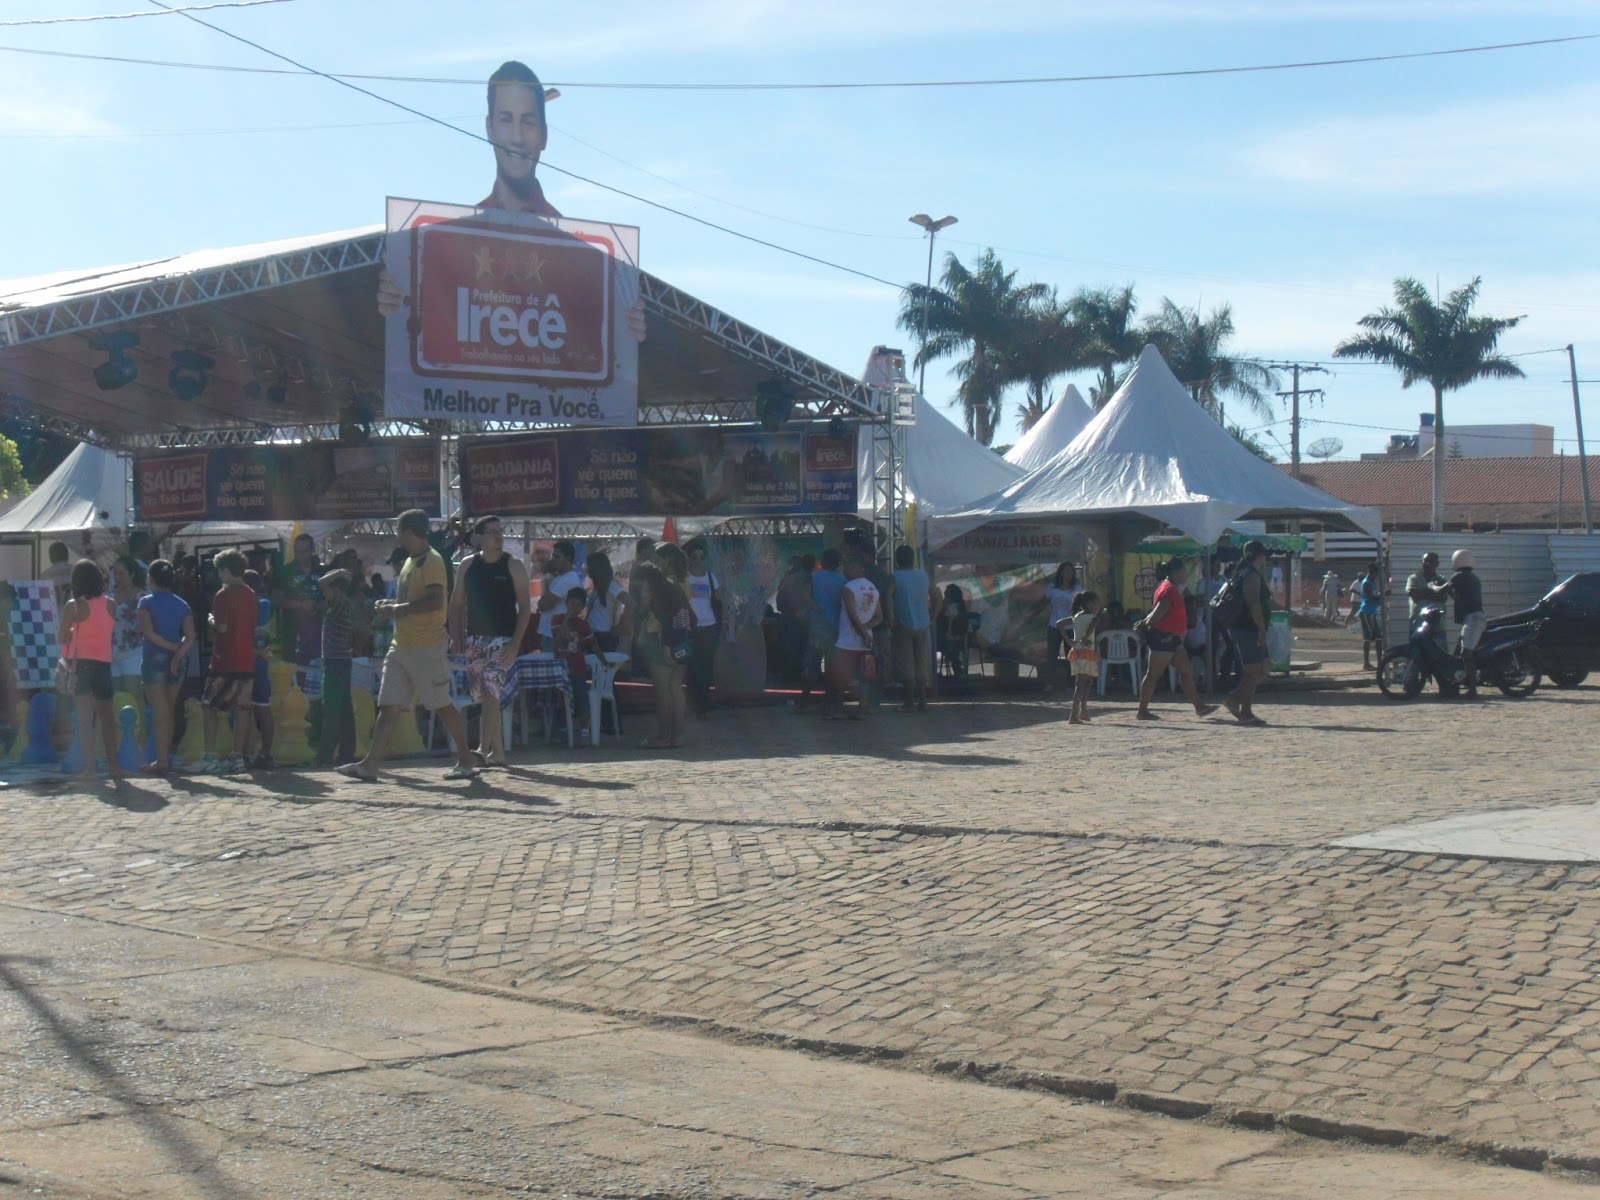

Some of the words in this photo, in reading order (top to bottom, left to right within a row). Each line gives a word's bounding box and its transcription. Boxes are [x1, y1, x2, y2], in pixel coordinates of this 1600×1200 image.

[473, 288, 521, 305] Prefeitura
[527, 293, 540, 306] de
[457, 286, 567, 350] Irecê
[460, 347, 512, 363] Trabalhando
[514, 352, 525, 362] ao
[527, 354, 540, 364] seu
[542, 351, 560, 365] lado
[423, 388, 499, 415] Melhor
[506, 392, 541, 416] Pra
[549, 393, 605, 420] Você.
[590, 448, 609, 463] Só
[611, 448, 637, 463] não
[470, 457, 553, 480] CIDADANIA
[577, 467, 595, 482] vê
[598, 468, 638, 483] quem
[142, 464, 202, 493] SAÚDE
[493, 479, 520, 493] Todo
[523, 476, 554, 491] Lado
[574, 484, 599, 499] não
[603, 485, 638, 502] quer.
